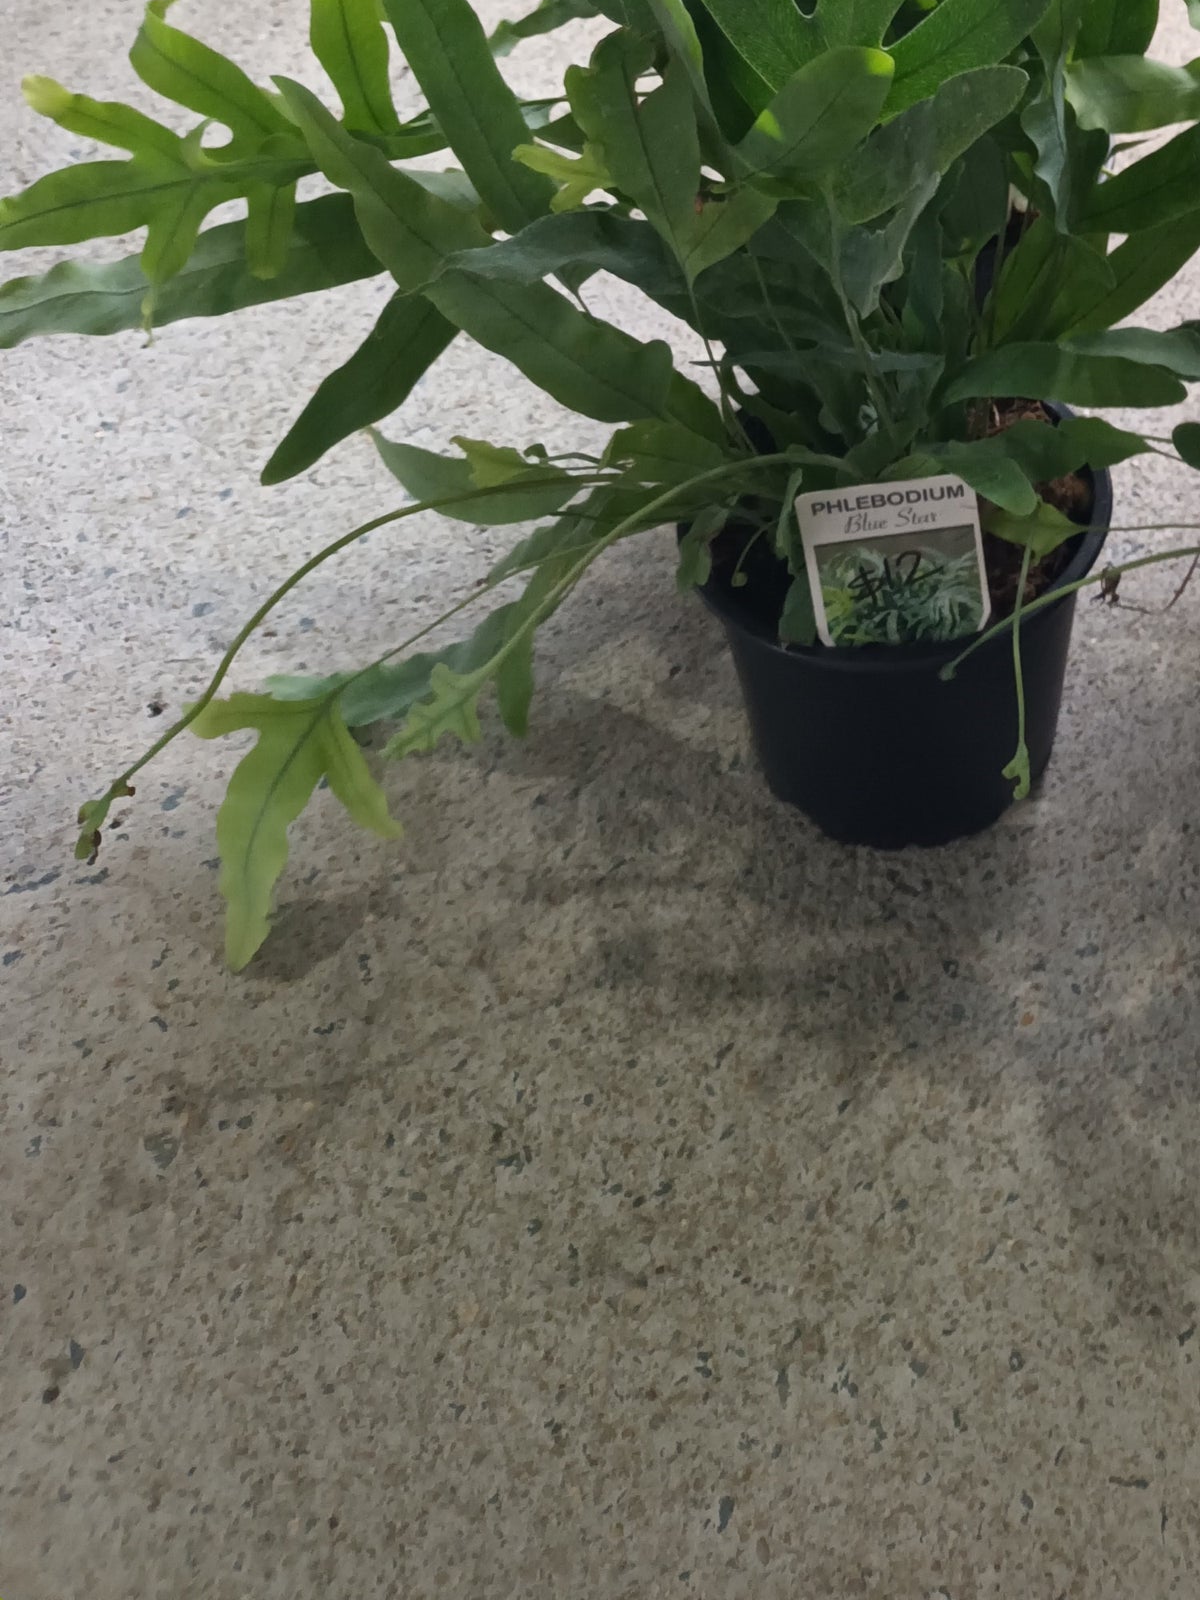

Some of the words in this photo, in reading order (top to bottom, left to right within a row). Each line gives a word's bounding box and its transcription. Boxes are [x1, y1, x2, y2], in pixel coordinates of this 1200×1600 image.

[811, 484, 965, 516] PHLEBODIUM
[844, 512, 888, 534] Blue
[894, 507, 938, 529] Star
[847, 549, 945, 607] $12
